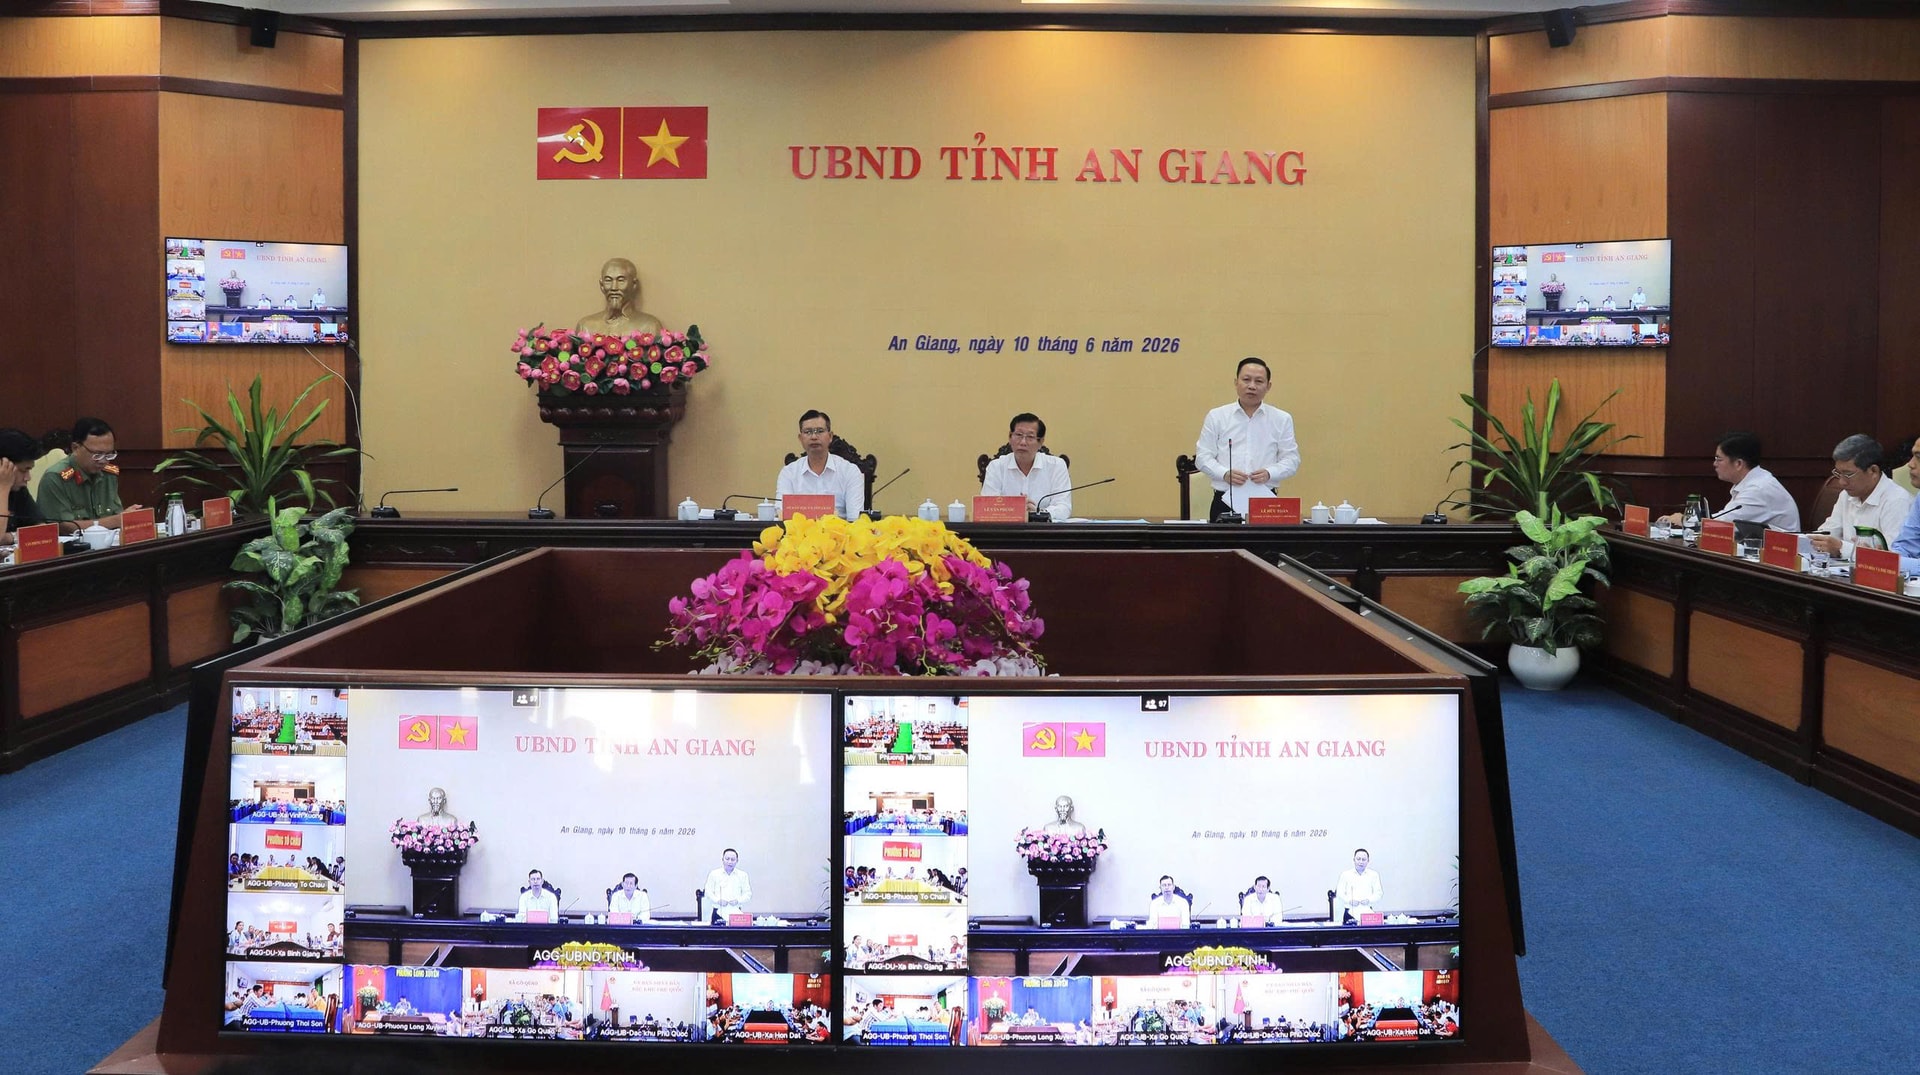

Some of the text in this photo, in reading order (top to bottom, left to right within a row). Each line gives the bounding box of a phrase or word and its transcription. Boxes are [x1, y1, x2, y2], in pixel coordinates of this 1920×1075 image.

[788, 132, 1307, 186] UBND TỈNH AN GIANG
[888, 335, 1180, 354] An Giang, ngày 10 tháng 6 năm 2026
[515, 736, 577, 753] UBND
[647, 739, 678, 755] AN
[686, 739, 756, 757] GIANG
[1144, 734, 1386, 758] UBND TỈNH AN GIANG
[561, 826, 570, 834] An
[598, 826, 614, 836] ngày
[629, 826, 648, 837] tháng
[678, 828, 696, 836] 2026
[1192, 830, 1201, 838] An
[1229, 830, 1246, 840] ngày
[1251, 830, 1258, 838] 10
[1261, 829, 1280, 839] tháng
[1291, 829, 1306, 837] năm
[1310, 829, 1327, 837] 2026
[533, 949, 635, 962] AGG-UBND TINH
[1165, 954, 1267, 967] AGG-UBND TINH
[243, 1018, 294, 1028] AGG-UB-Phuong
[409, 1023, 424, 1032] Long
[863, 1032, 917, 1041] AGG-UB-Phuong
[1038, 1034, 1053, 1042] Long
